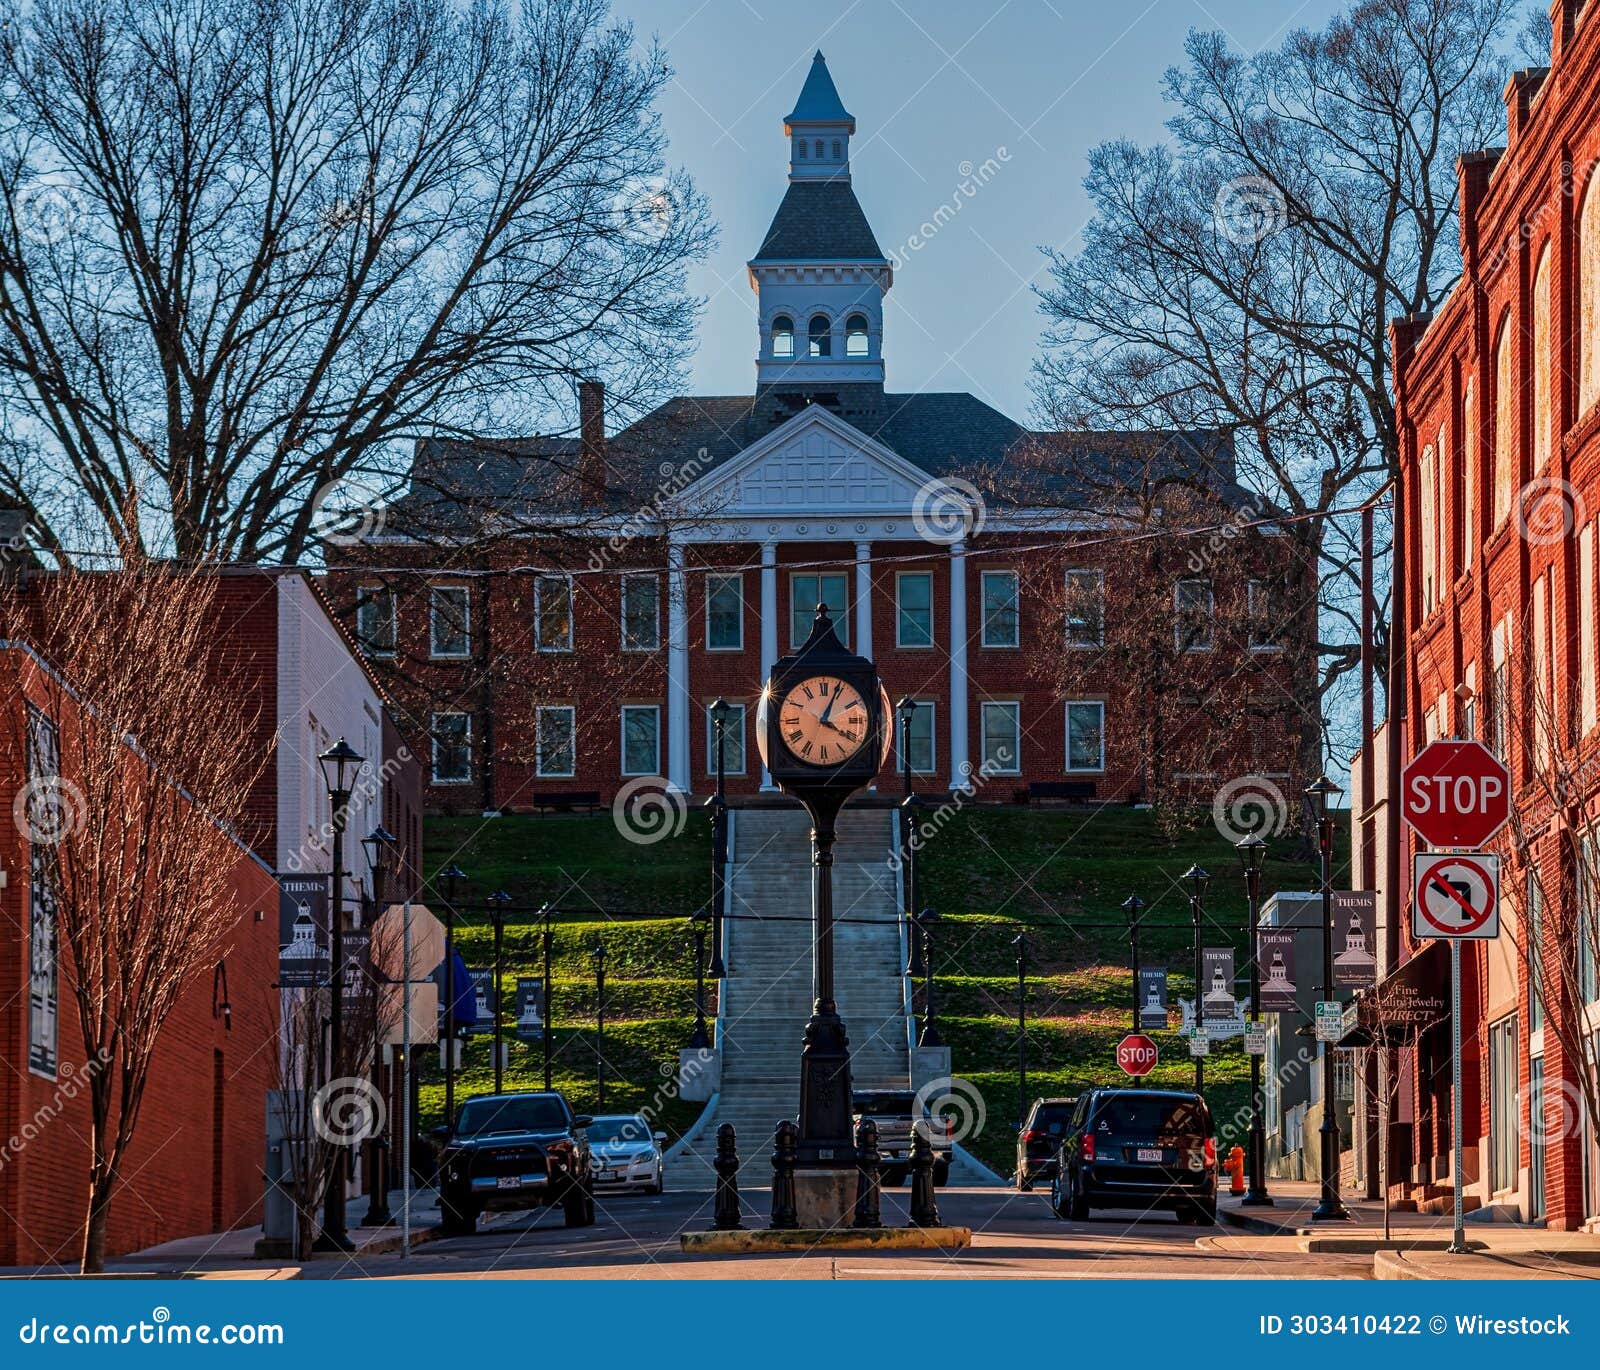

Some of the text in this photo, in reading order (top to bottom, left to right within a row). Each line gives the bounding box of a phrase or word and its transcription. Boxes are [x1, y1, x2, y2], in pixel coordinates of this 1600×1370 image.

[1409, 775, 1503, 815] STOP
[283, 881, 325, 892] THEMIS
[1336, 898, 1373, 908] THEMIS
[342, 936, 370, 945] HEMIS
[1263, 935, 1293, 944] THEMIS
[1206, 953, 1232, 961] THEMIS
[1395, 985, 1418, 995] Fine
[1407, 996, 1445, 1009] Jewelry
[1383, 1010, 1431, 1021] DIRECT
[1120, 1047, 1156, 1064] STOP
